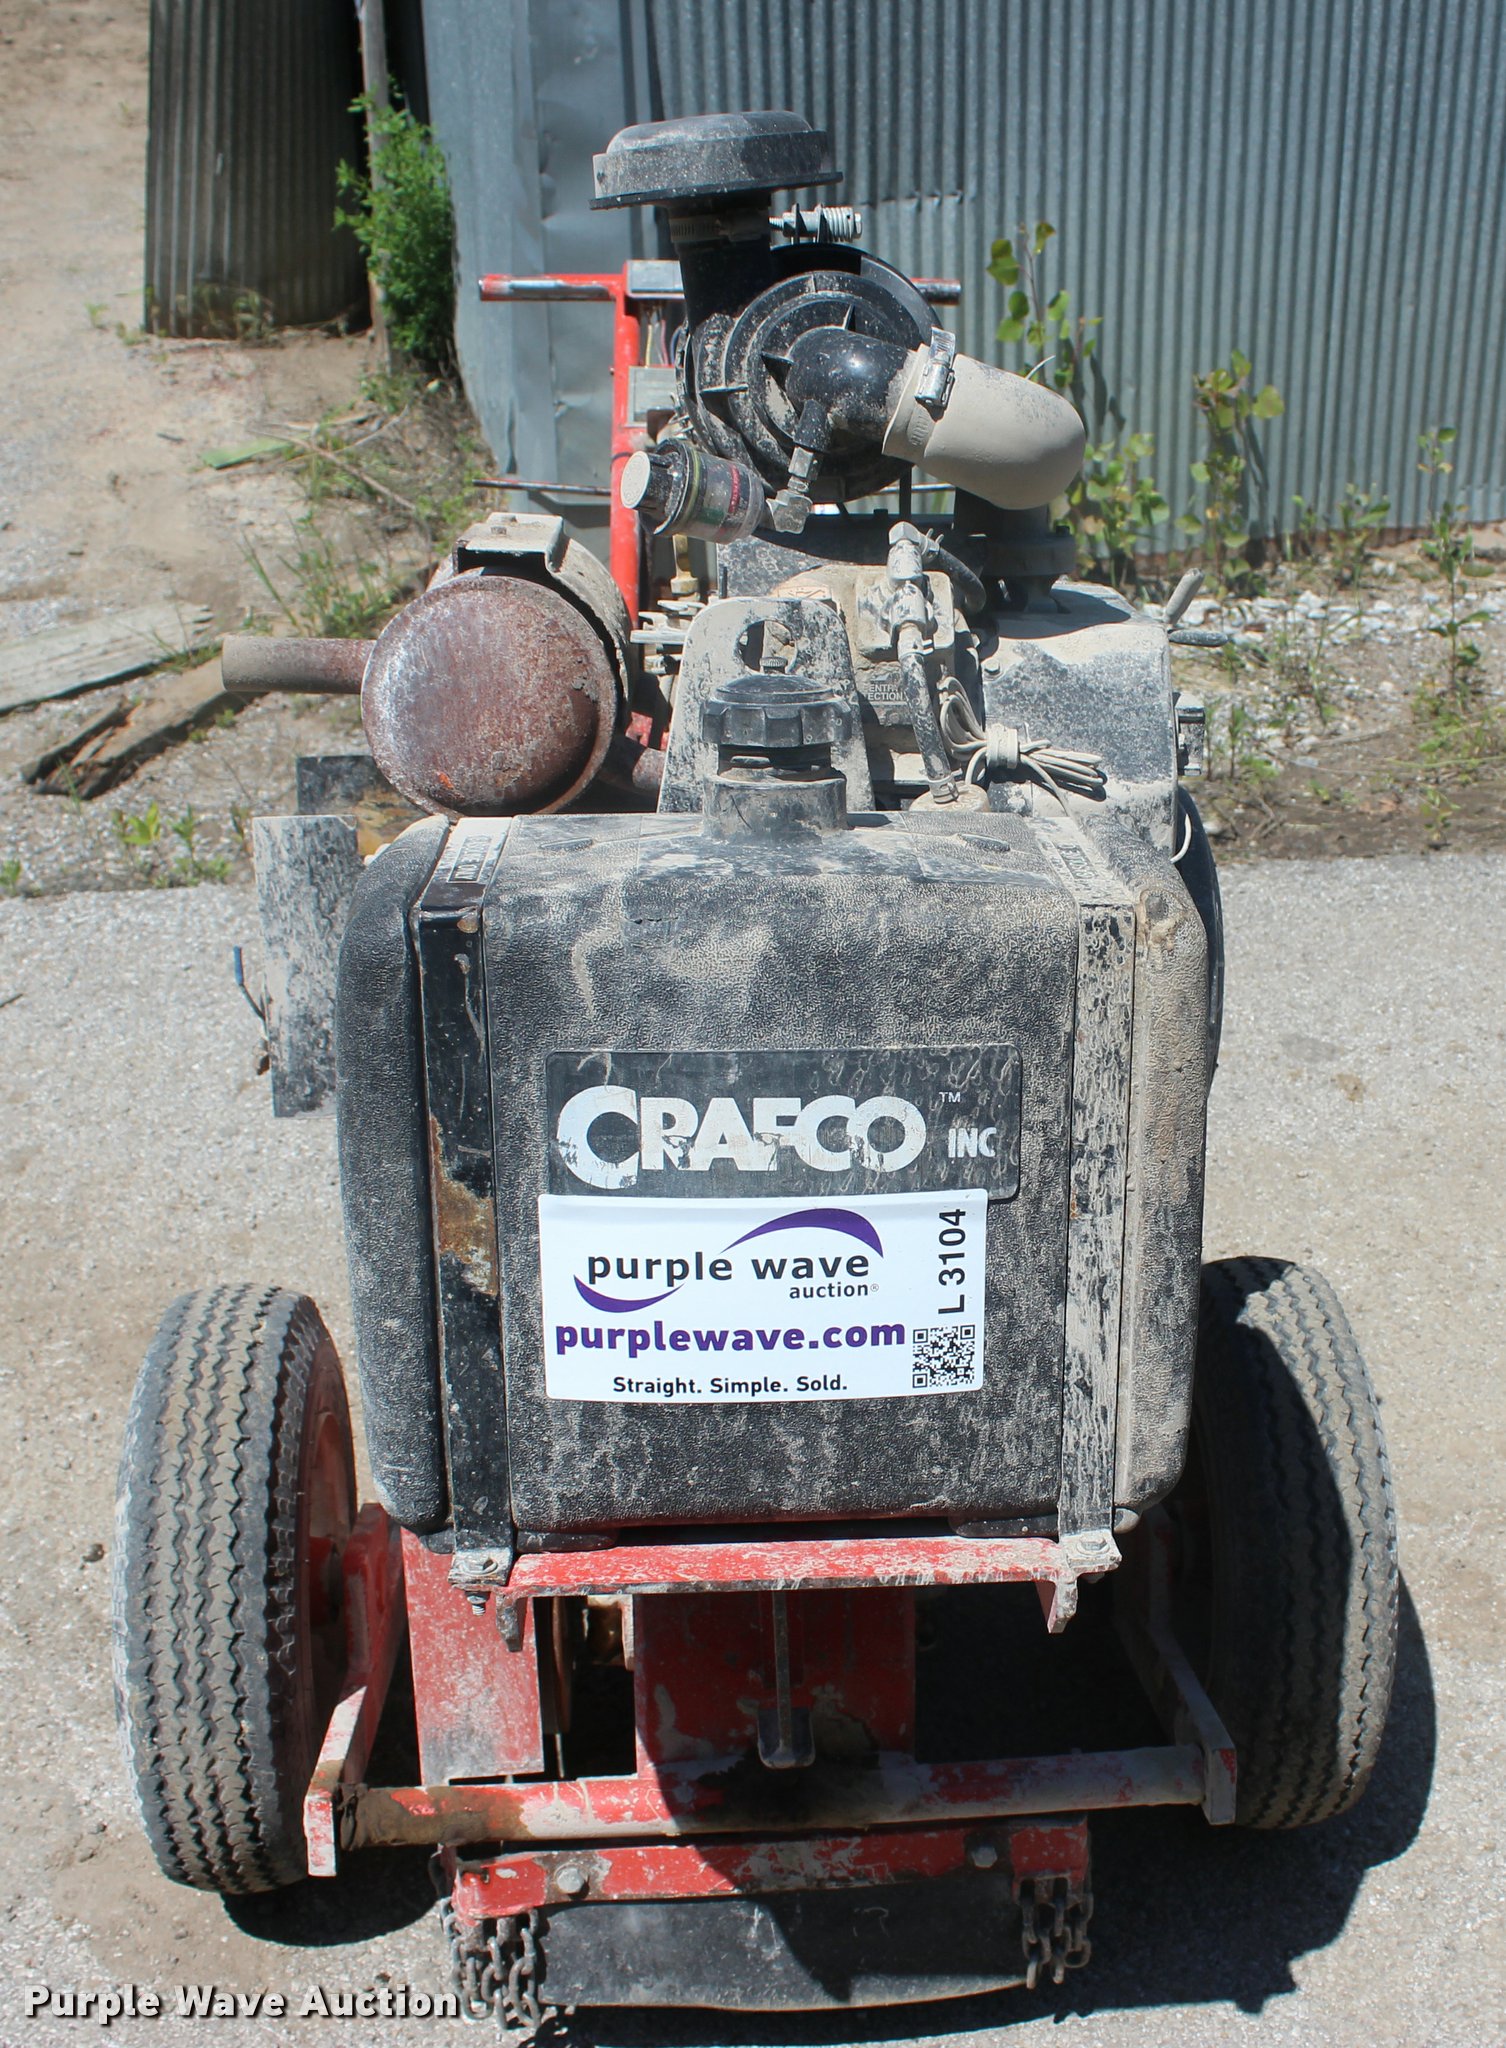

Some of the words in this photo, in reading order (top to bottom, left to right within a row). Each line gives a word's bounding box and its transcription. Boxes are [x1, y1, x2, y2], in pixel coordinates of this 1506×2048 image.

[938, 1091, 961, 1103] TM
[556, 1084, 926, 1190] CRAFCO
[949, 1126, 997, 1158] INC
[938, 1208, 967, 1287] 3104
[588, 1251, 732, 1287] purple
[751, 1255, 869, 1280] wave
[938, 1294, 965, 1315] L
[556, 1320, 905, 1358] purplewave.com
[613, 1376, 702, 1397] Straight.
[710, 1377, 788, 1397] Simple.
[796, 1374, 848, 1392] Sold.
